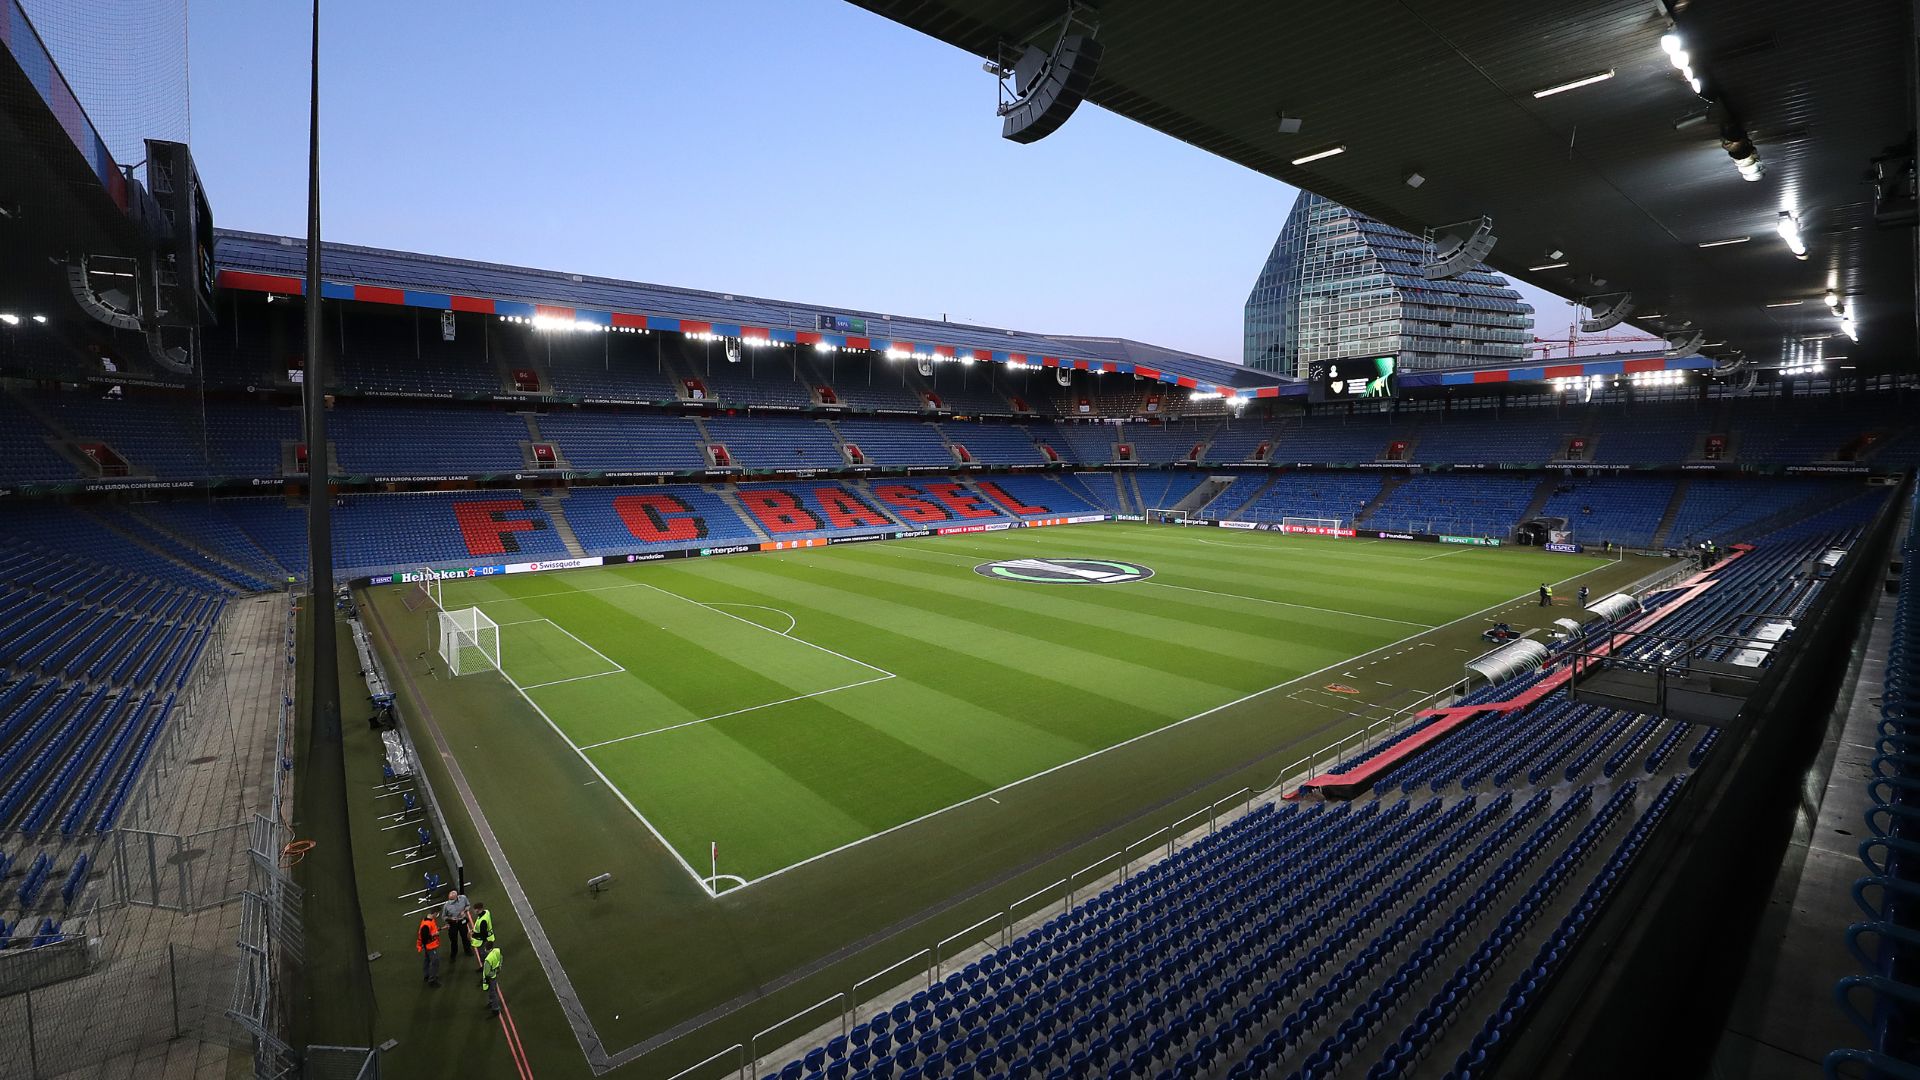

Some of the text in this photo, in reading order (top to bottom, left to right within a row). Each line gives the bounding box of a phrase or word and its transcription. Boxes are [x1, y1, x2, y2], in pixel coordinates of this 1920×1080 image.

[735, 482, 1053, 533] BASEL
[1174, 517, 1209, 525] enerprise
[702, 545, 749, 556] enterprise
[635, 553, 664, 561] Foundation
[539, 560, 581, 569] Swissquote
[402, 569, 465, 583] Heineken
